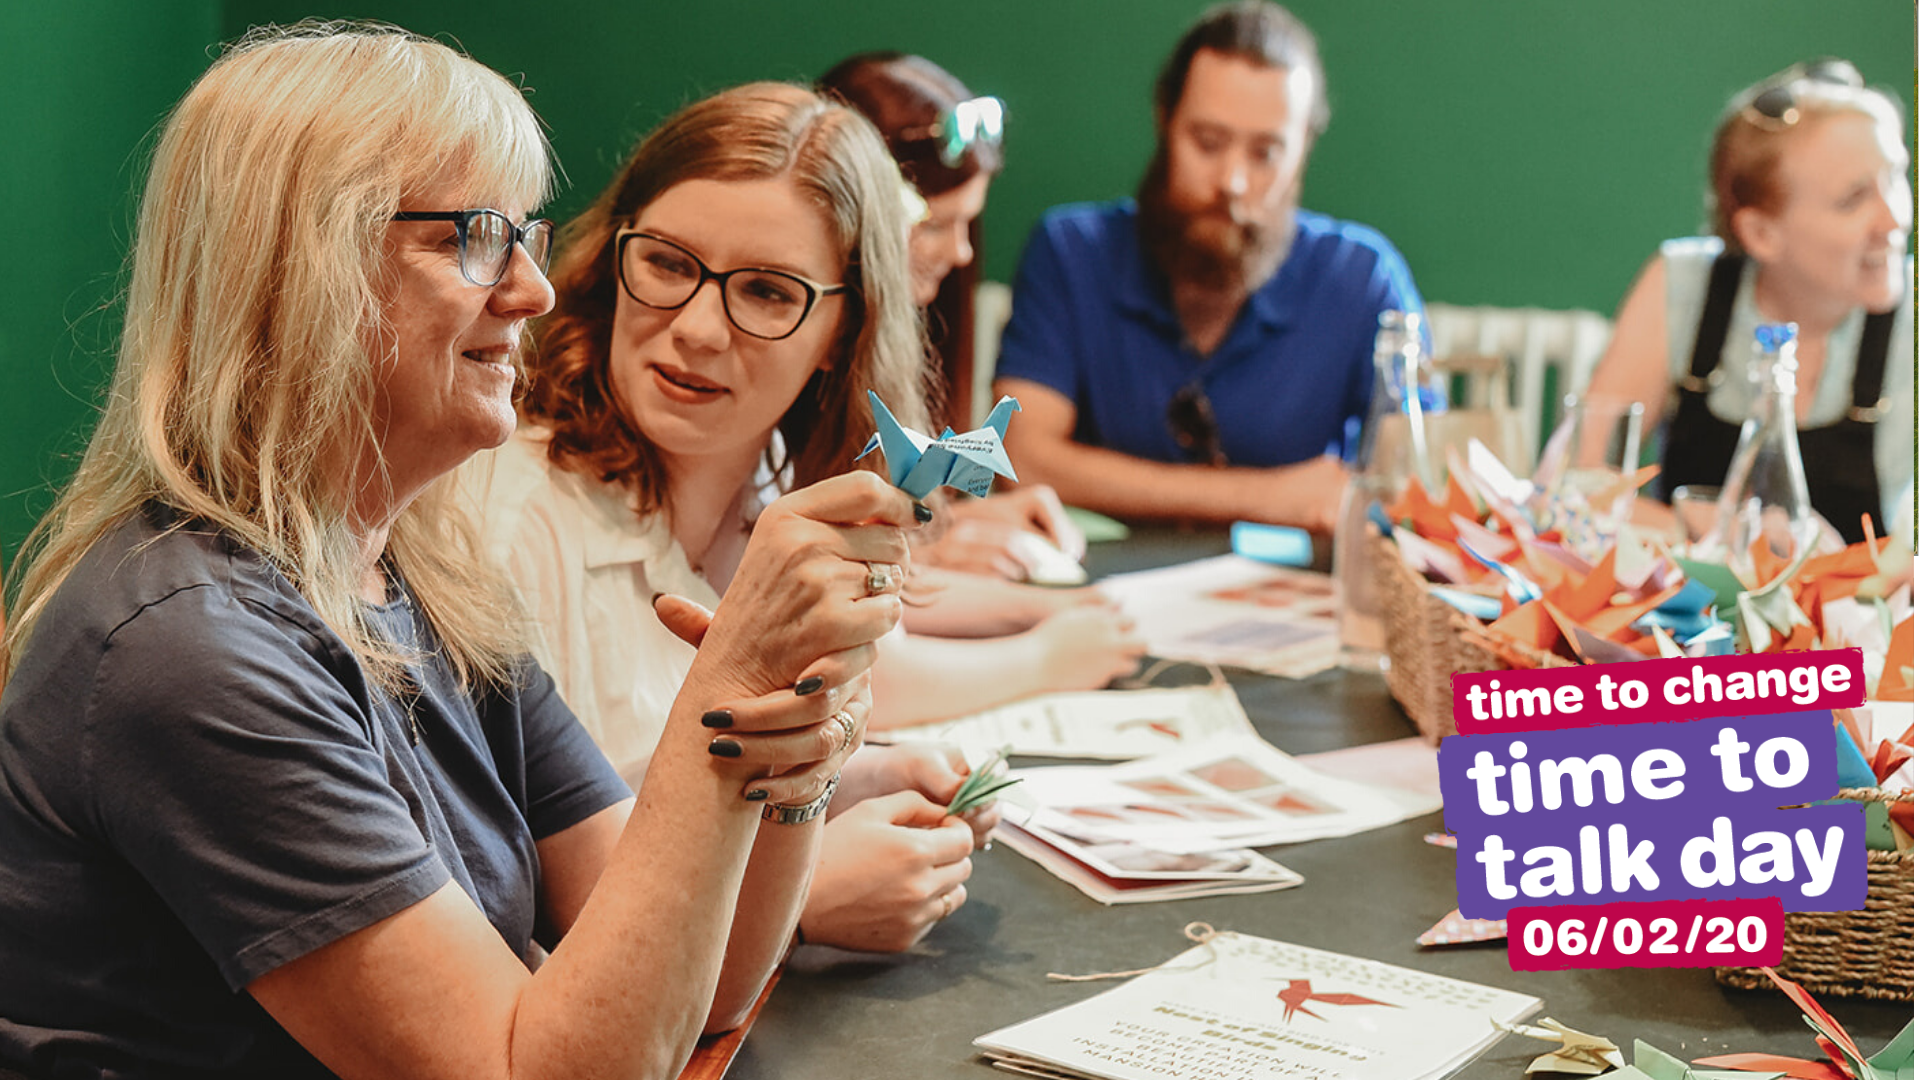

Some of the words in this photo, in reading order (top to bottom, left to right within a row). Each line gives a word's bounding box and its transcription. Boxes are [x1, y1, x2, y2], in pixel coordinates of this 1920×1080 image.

[1109, 1029, 1198, 1052] BECOME
[1203, 1051, 1260, 1067] PART
[1269, 1066, 1298, 1075] OF
[1115, 1020, 1170, 1038] YOUR
[1176, 1036, 1285, 1064] CREATION
[1153, 1006, 1220, 1025] Nest
[1222, 1024, 1258, 1032] of
[1257, 1031, 1367, 1061] Singing
[1201, 1030, 1277, 1051] Birds
[1073, 1037, 1229, 1078] INSTALLATION
[1083, 1049, 1183, 1077] MANSION
[1136, 1044, 1253, 1075] BEAUTIFUL
